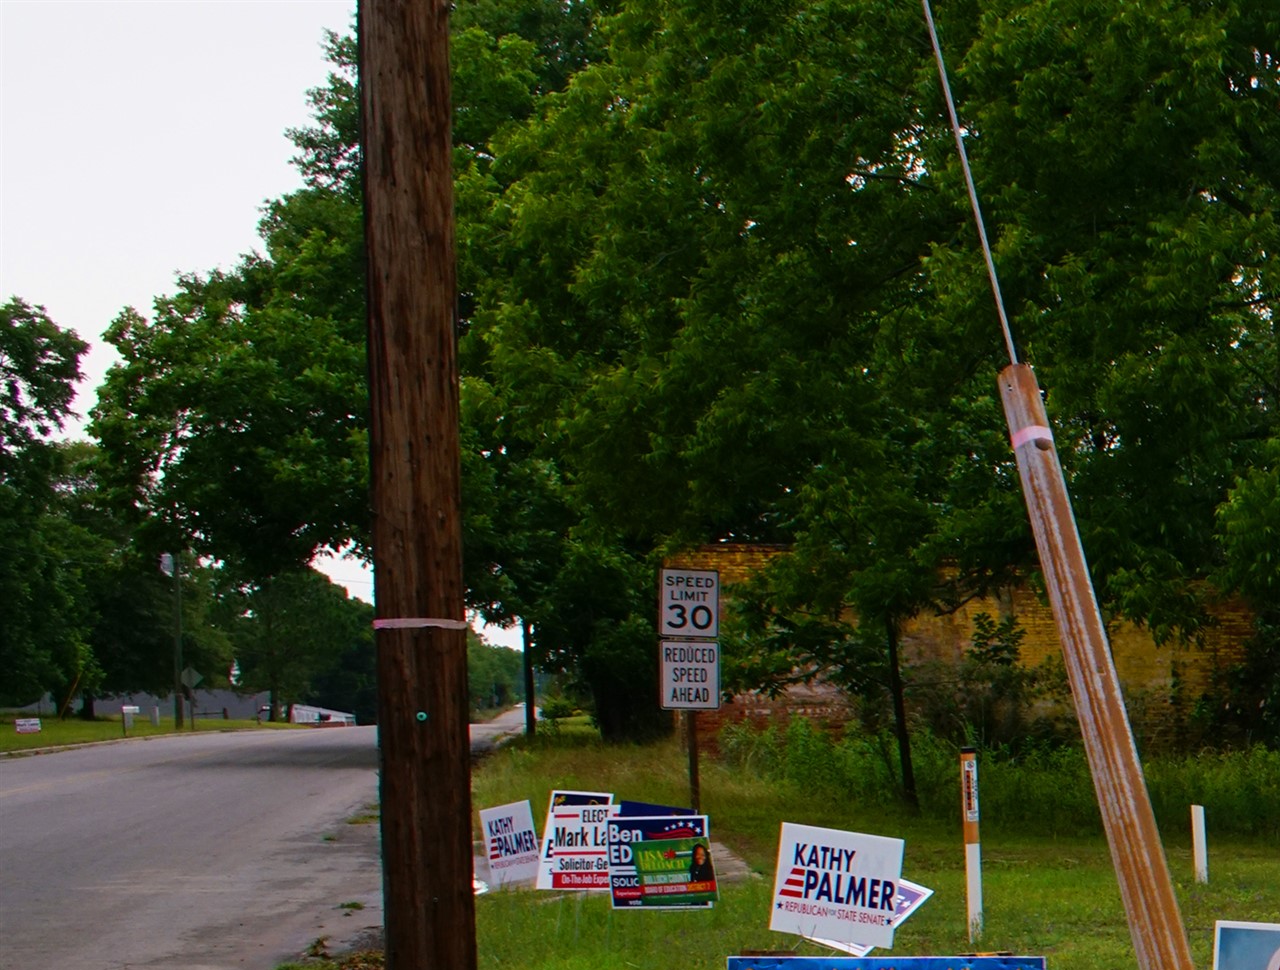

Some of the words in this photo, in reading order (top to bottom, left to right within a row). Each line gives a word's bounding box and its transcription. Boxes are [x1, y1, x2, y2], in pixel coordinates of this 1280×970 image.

[665, 575, 714, 588] SPEED
[670, 590, 709, 601] LIMIT
[666, 604, 712, 630] 30
[664, 647, 715, 663] REDUCED
[672, 667, 707, 682] SPEED
[671, 687, 710, 702] AHEAD
[582, 809, 609, 823] ELECT
[488, 815, 514, 837] KATHY
[608, 824, 642, 842] Ben
[497, 829, 537, 857] PALMER
[556, 826, 588, 847] Mark
[609, 845, 633, 863] ED
[794, 843, 856, 872] KATHY
[803, 869, 895, 911] PALMER
[785, 901, 828, 917] REPUBLICAN
[836, 908, 857, 922] STATE
[858, 912, 885, 926] SENATE
